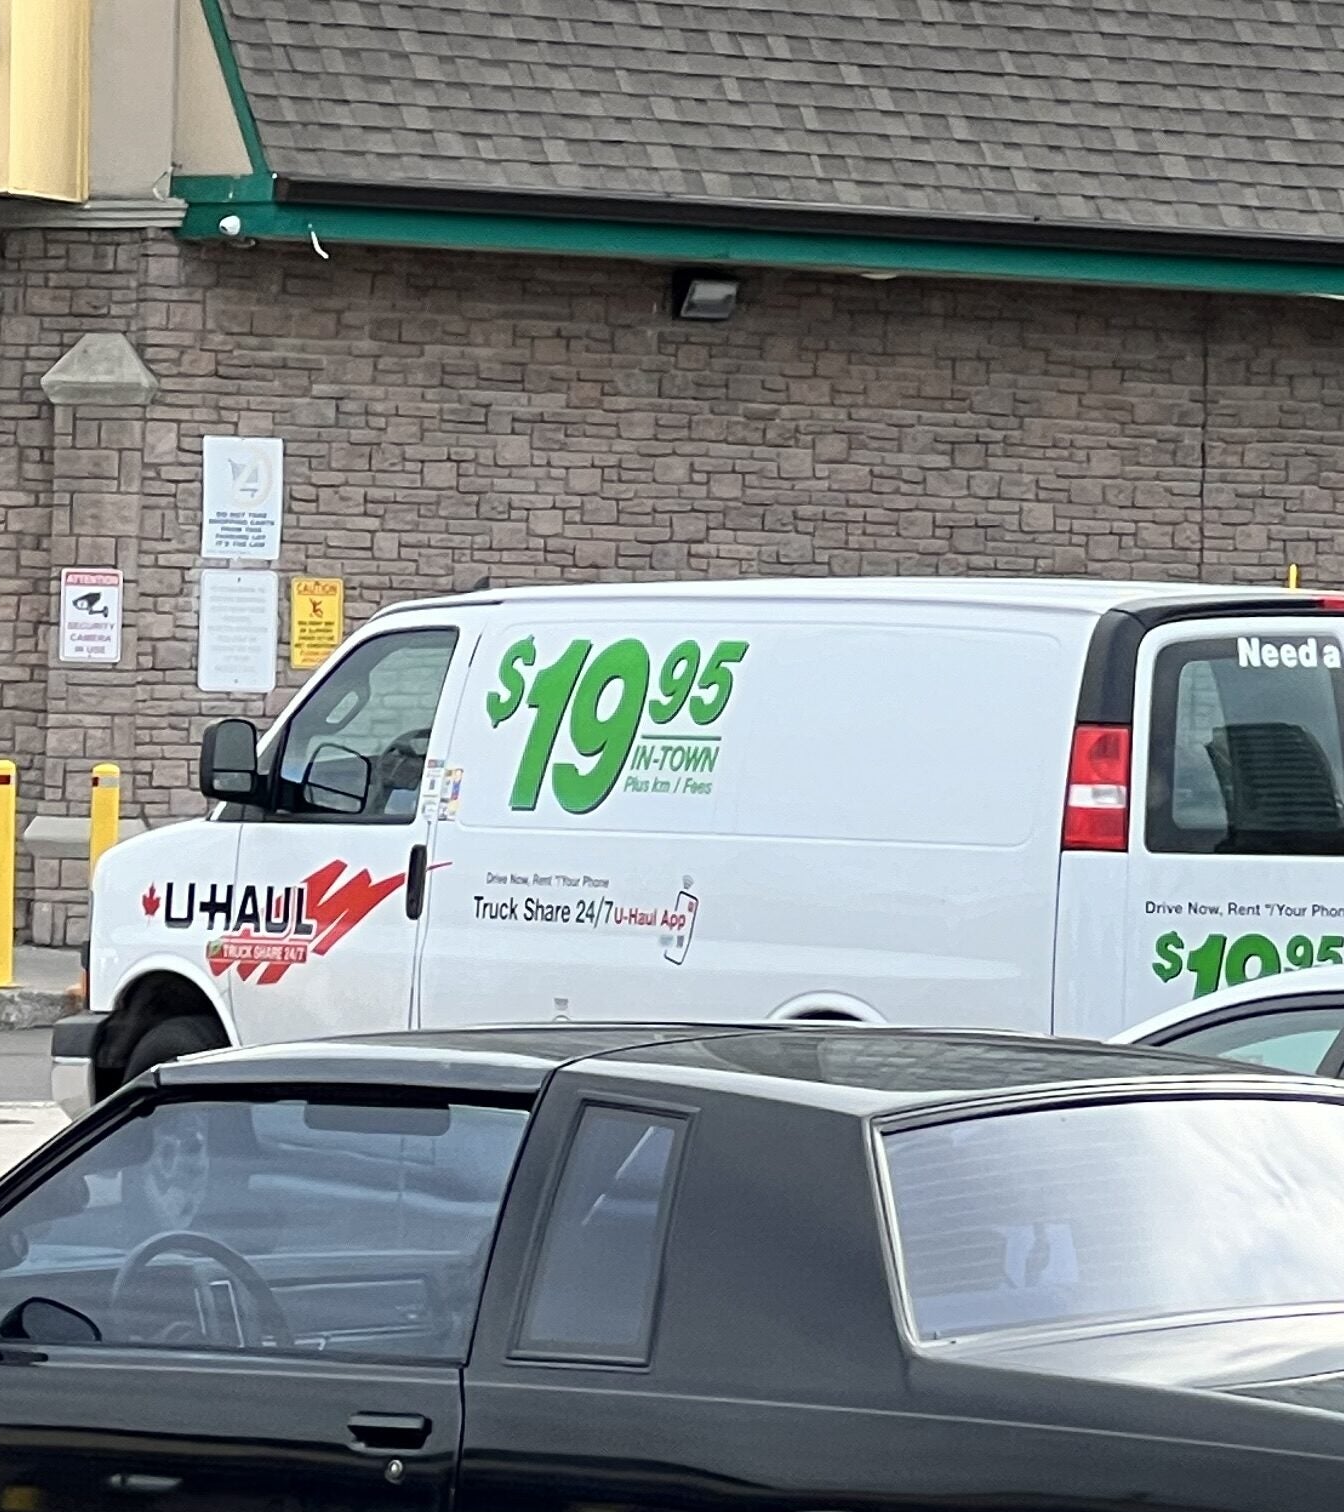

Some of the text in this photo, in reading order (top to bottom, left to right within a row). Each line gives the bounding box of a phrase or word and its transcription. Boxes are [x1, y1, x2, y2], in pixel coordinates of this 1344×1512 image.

[1237, 636, 1318, 668] Need
[1323, 643, 1342, 668] a
[630, 744, 720, 773] IN-TOWN
[623, 775, 650, 793] Plus
[651, 775, 671, 793] km
[682, 777, 713, 795] Fees
[164, 881, 314, 936] U-HAUL
[473, 895, 686, 931] Truck Share 24/7 U-Haul App
[1145, 901, 1183, 915] Drive
[1187, 901, 1223, 917] Now,
[1227, 901, 1261, 916] Rent
[223, 944, 253, 959] TRUCK
